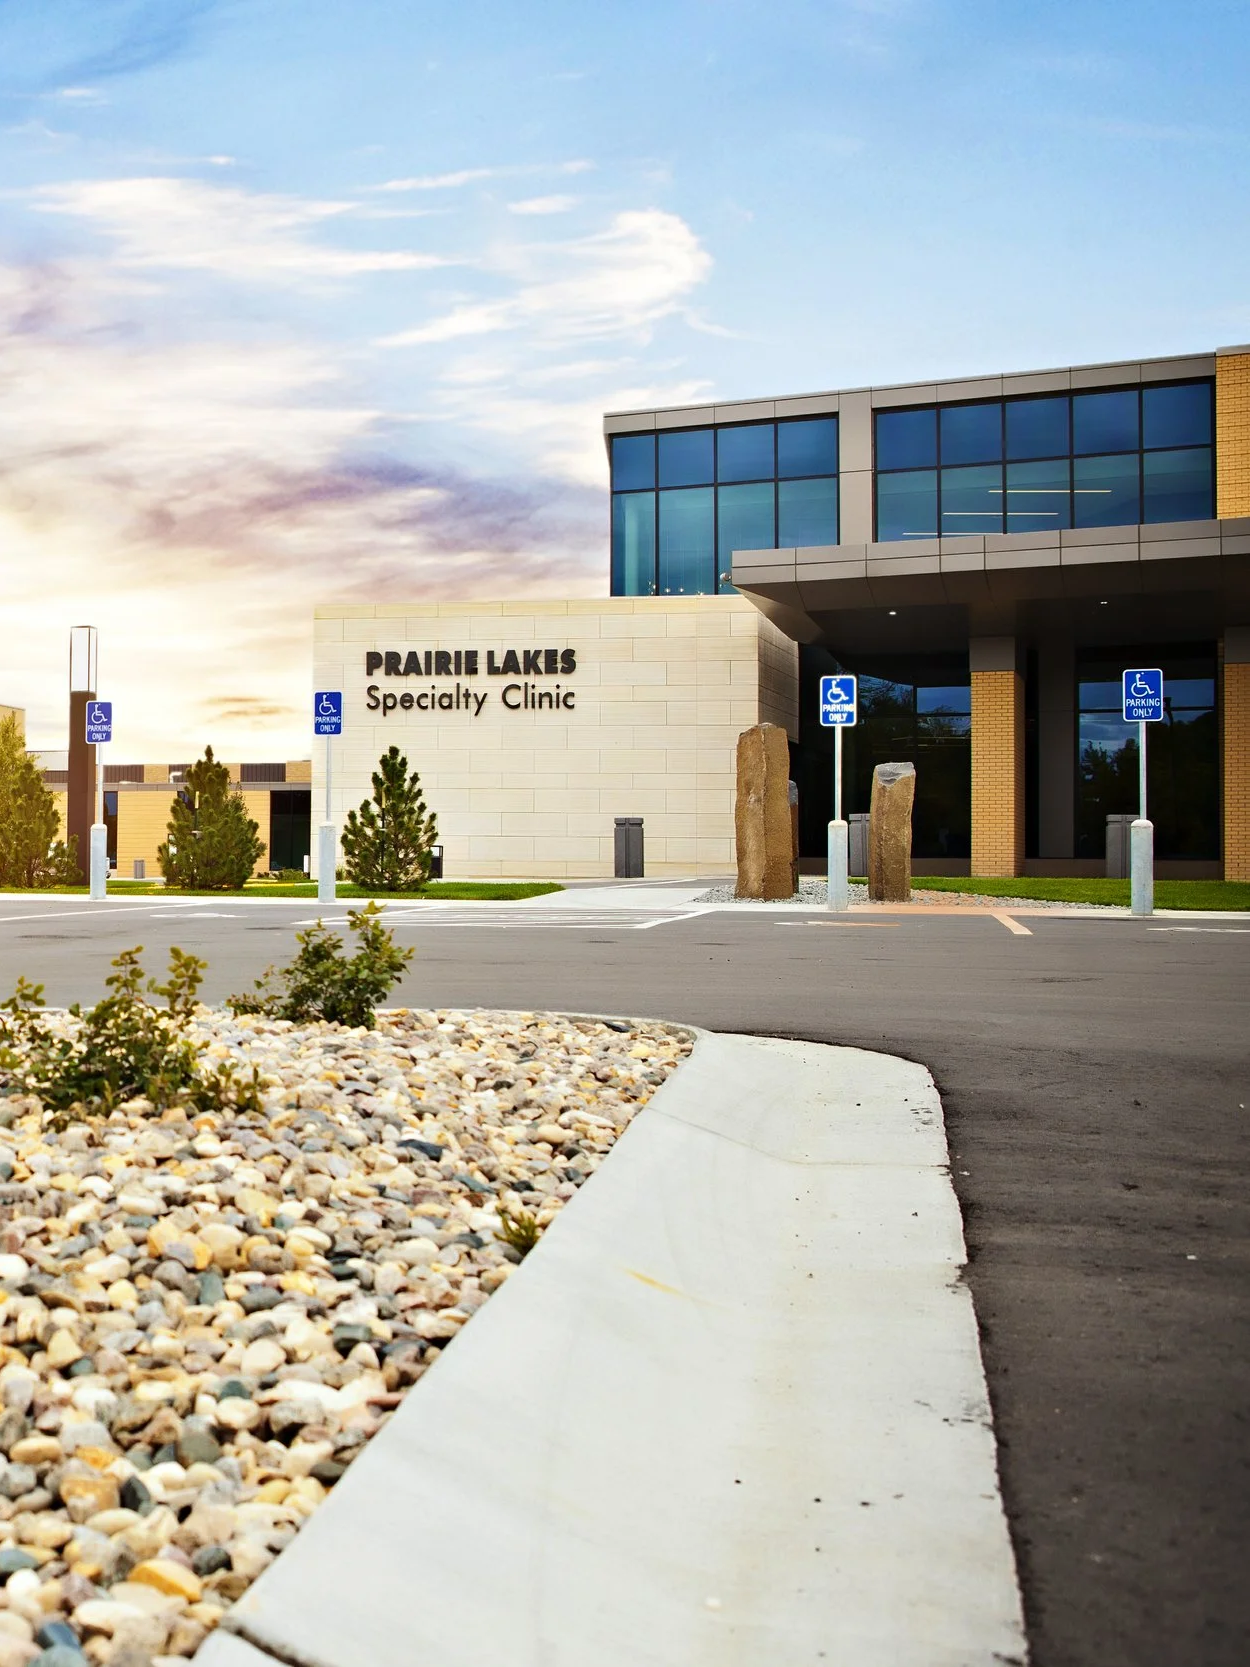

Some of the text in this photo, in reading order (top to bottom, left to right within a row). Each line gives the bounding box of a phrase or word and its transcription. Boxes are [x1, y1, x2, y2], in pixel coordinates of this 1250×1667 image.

[366, 649, 577, 676] PRAIRIE LAKES
[366, 682, 575, 717] Specialty Clinic
[1126, 698, 1160, 707] PARKING
[822, 704, 855, 712] PARKING
[1132, 708, 1153, 717] ONLY
[315, 716, 341, 724] PARKING
[829, 713, 848, 722] ONLY
[87, 724, 111, 732] PARKING
[320, 724, 336, 732] ONLY
[92, 732, 106, 740] ONLY
